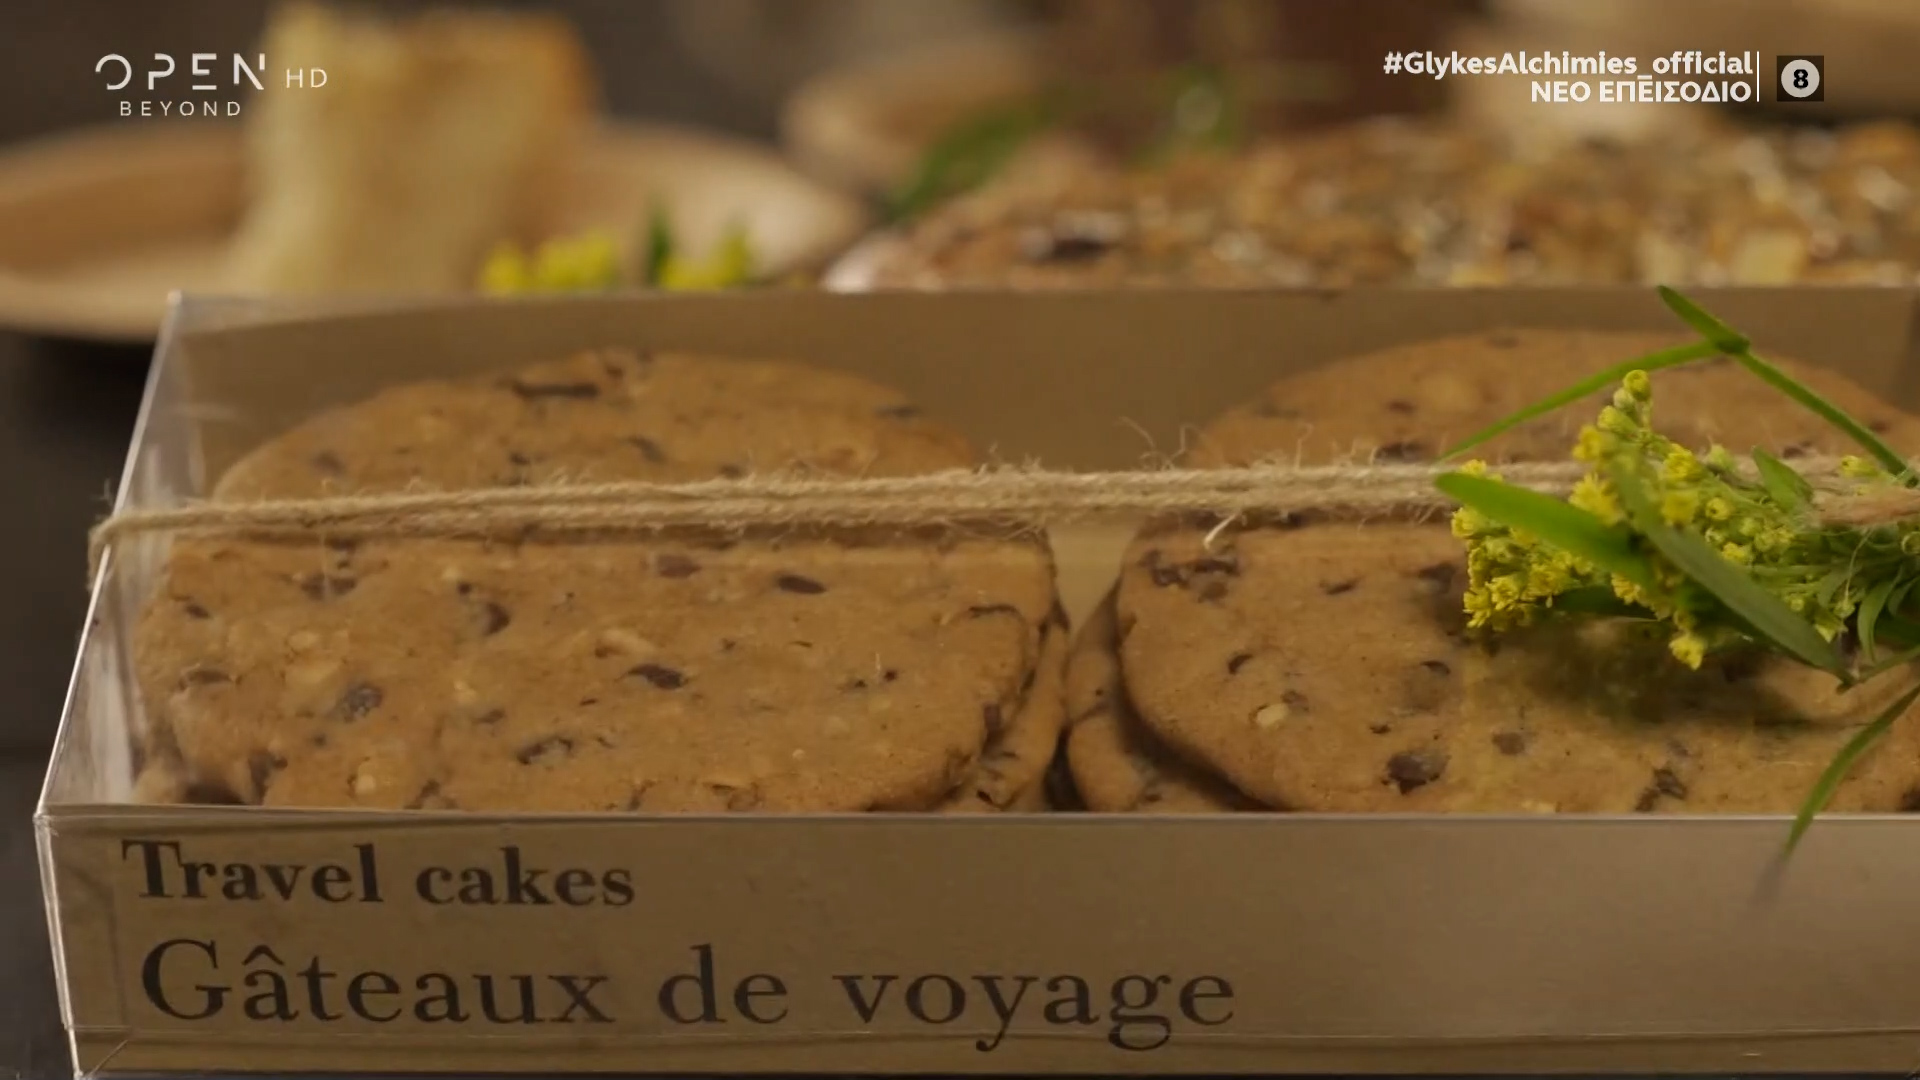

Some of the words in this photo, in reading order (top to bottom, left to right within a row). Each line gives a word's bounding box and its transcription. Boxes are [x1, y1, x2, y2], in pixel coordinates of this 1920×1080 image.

[121, 839, 384, 904] Travel
[415, 846, 635, 907] cakes
[141, 938, 613, 1024] Gâteaux
[657, 943, 788, 1025] de
[832, 974, 1236, 1051] voyage
